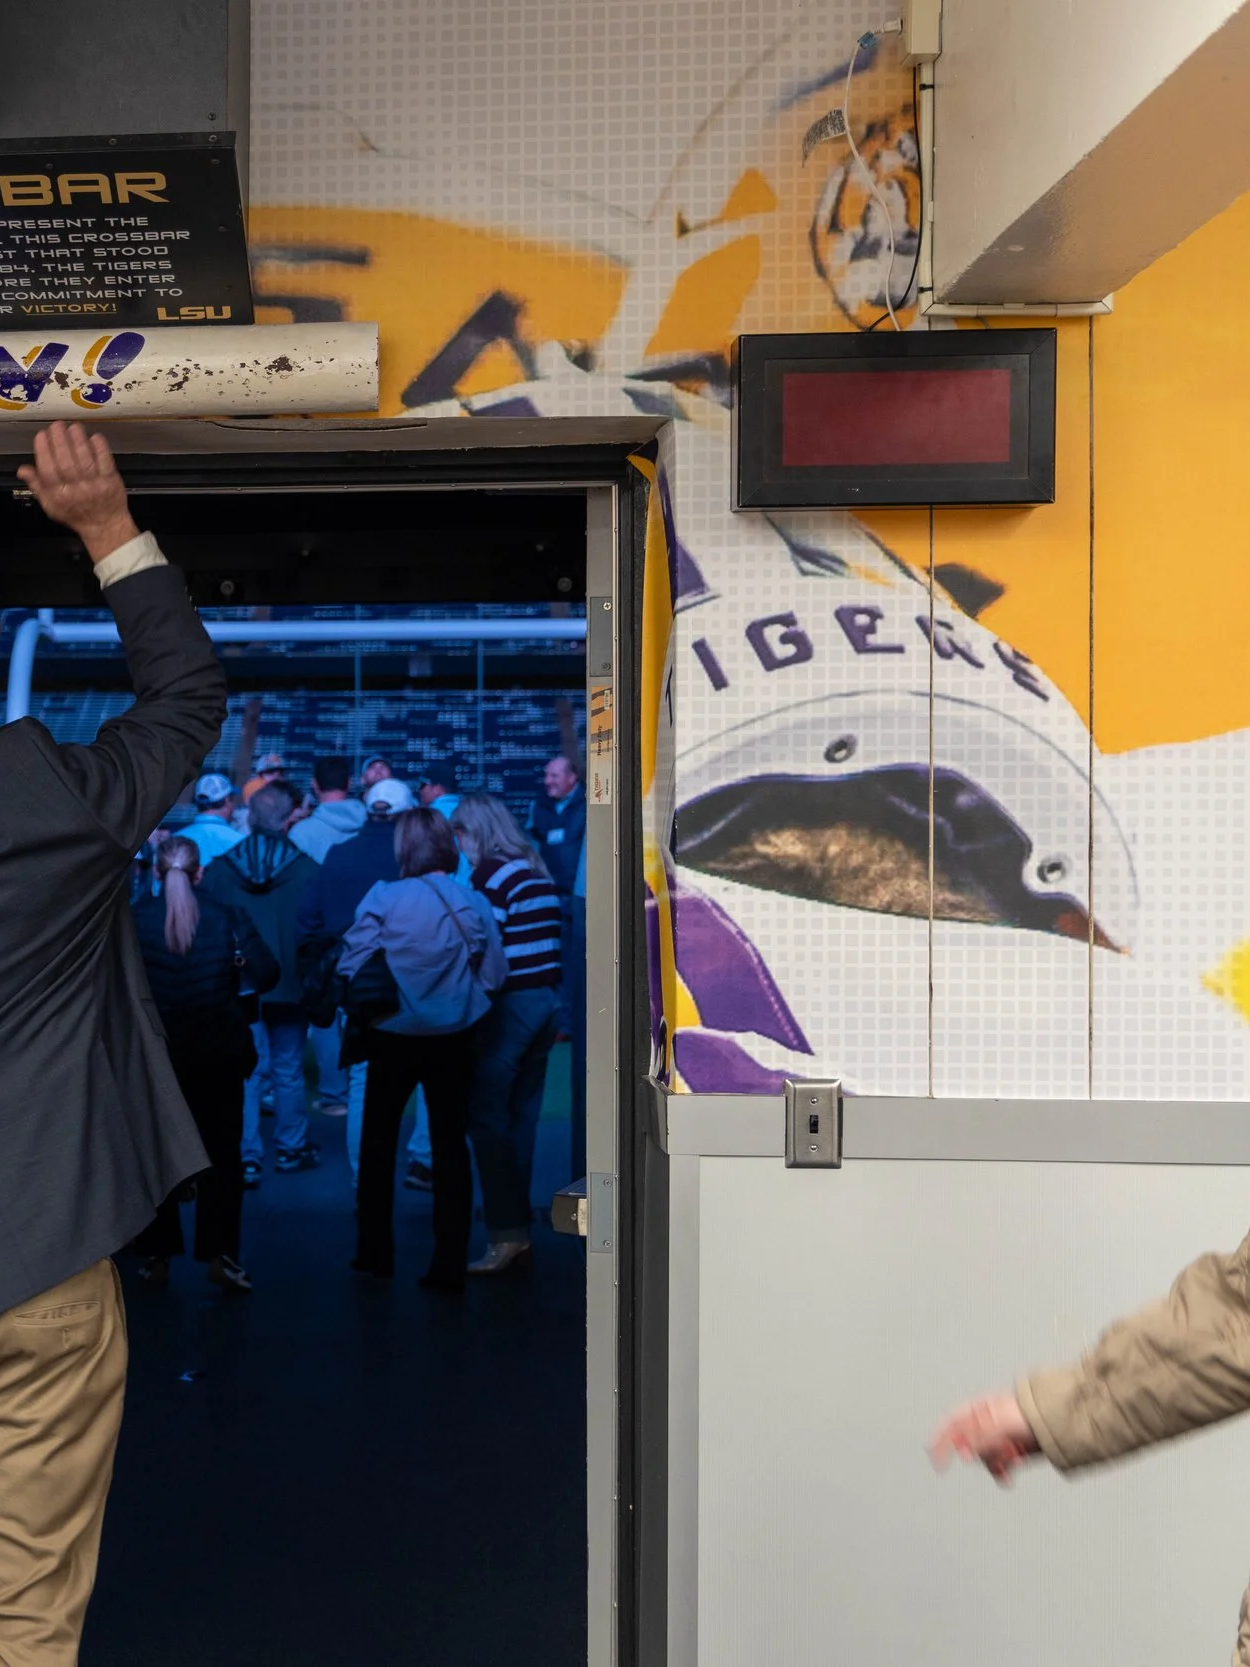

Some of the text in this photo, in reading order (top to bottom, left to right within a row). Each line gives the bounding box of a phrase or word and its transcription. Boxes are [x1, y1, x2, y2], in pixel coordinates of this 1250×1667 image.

[105, 217, 149, 227] THE
[11, 233, 61, 245] THIS
[68, 230, 191, 243] CROSSBAR
[24, 247, 85, 259] THAT
[93, 246, 169, 257] STOOD
[42, 262, 85, 272] THE
[92, 260, 172, 271] TIGERS
[39, 276, 95, 287] THEY
[104, 274, 176, 285] ENTER
[1, 288, 147, 301] COMMITMENT
[154, 287, 184, 298] TO
[21, 303, 117, 314] VICTORY!
[157, 305, 232, 321] LSU
